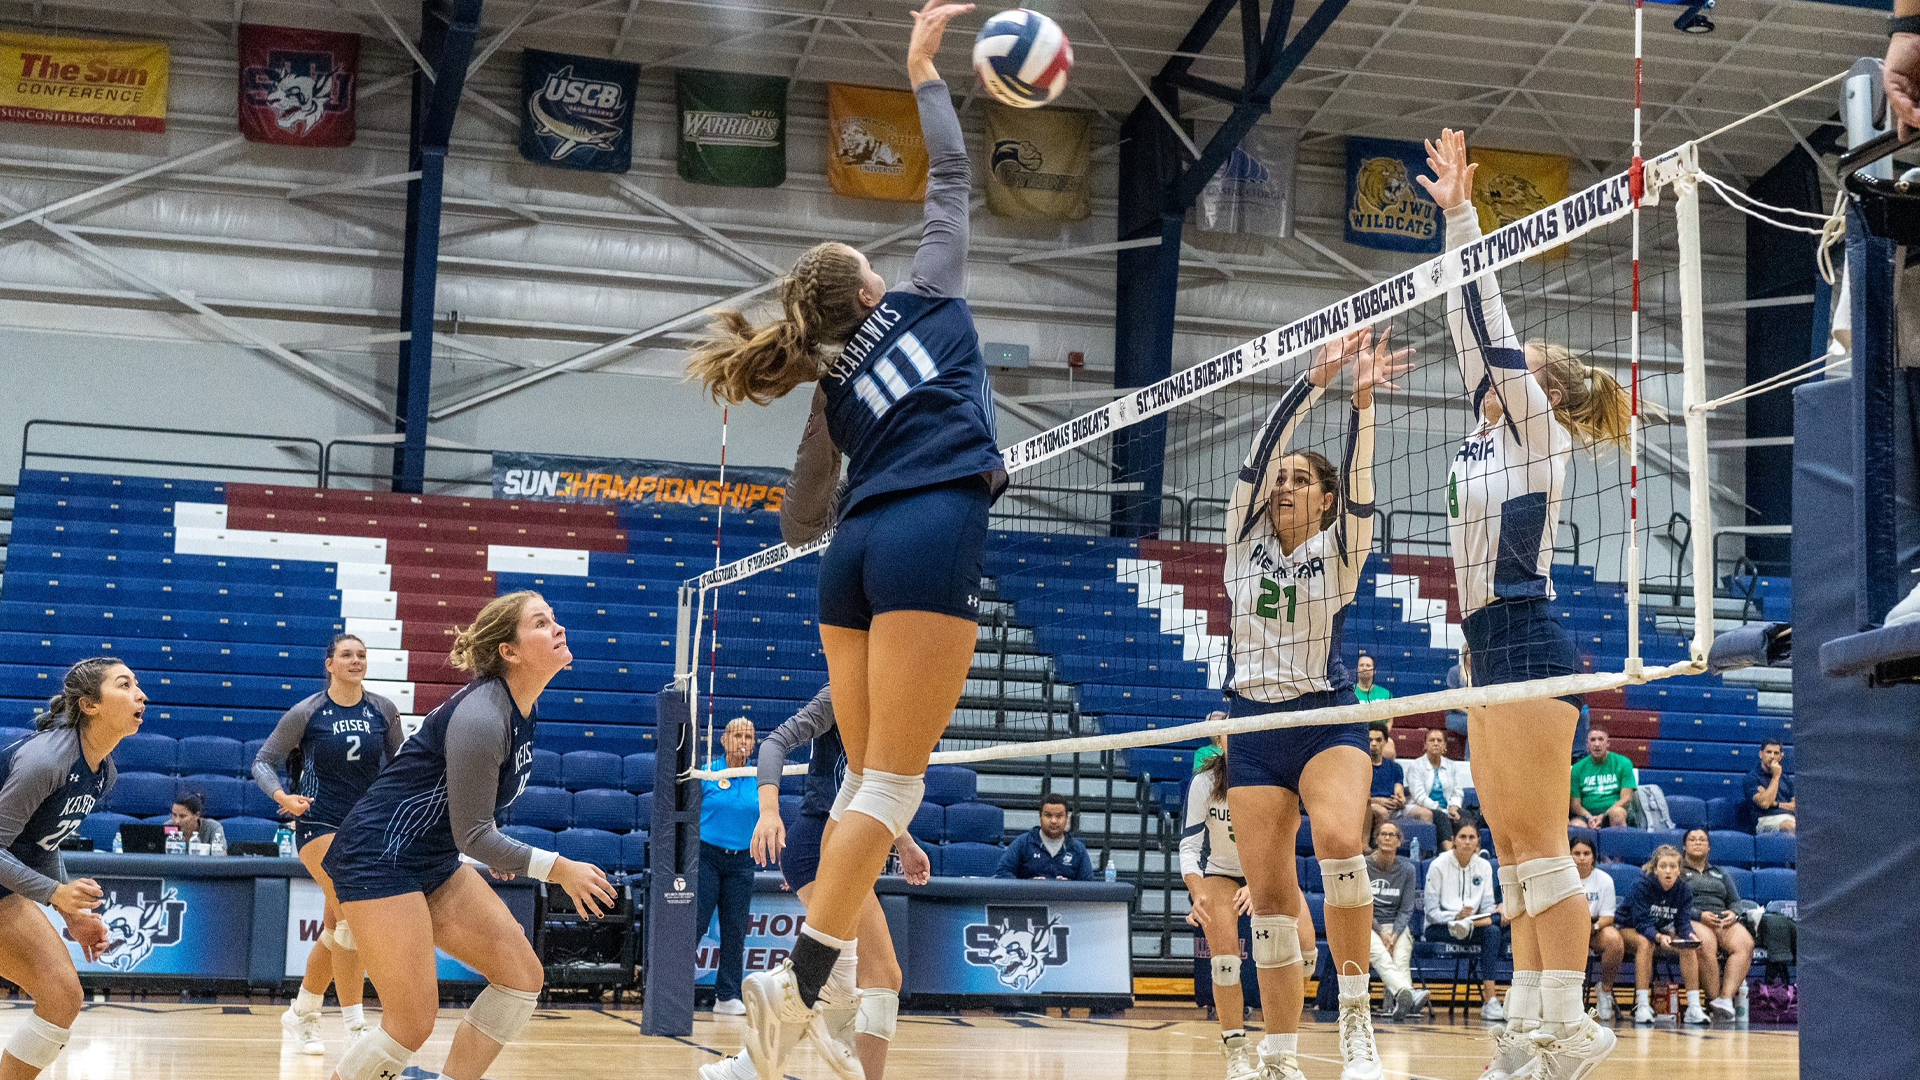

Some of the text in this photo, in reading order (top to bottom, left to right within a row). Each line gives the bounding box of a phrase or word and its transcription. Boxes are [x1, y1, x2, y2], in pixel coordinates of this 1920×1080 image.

[21, 53, 148, 86] The Sun
[17, 83, 143, 102] CONFERENCE
[545, 77, 619, 108] USCB
[685, 113, 777, 136] WARRIORS
[1399, 201, 1433, 218] JWU
[1353, 213, 1433, 236] WILDCATS
[1352, 272, 1416, 323] BOBCATS
[828, 303, 901, 386] SEAHAWKS
[1194, 349, 1243, 391] BOBCATS
[1072, 407, 1110, 442] BOBCATS
[503, 470, 559, 497] SUN
[1256, 577, 1297, 623] 21
[333, 720, 371, 735] KEISER
[346, 735, 361, 761] 2
[515, 741, 533, 774] KEIS
[59, 794, 96, 816] KEISER
